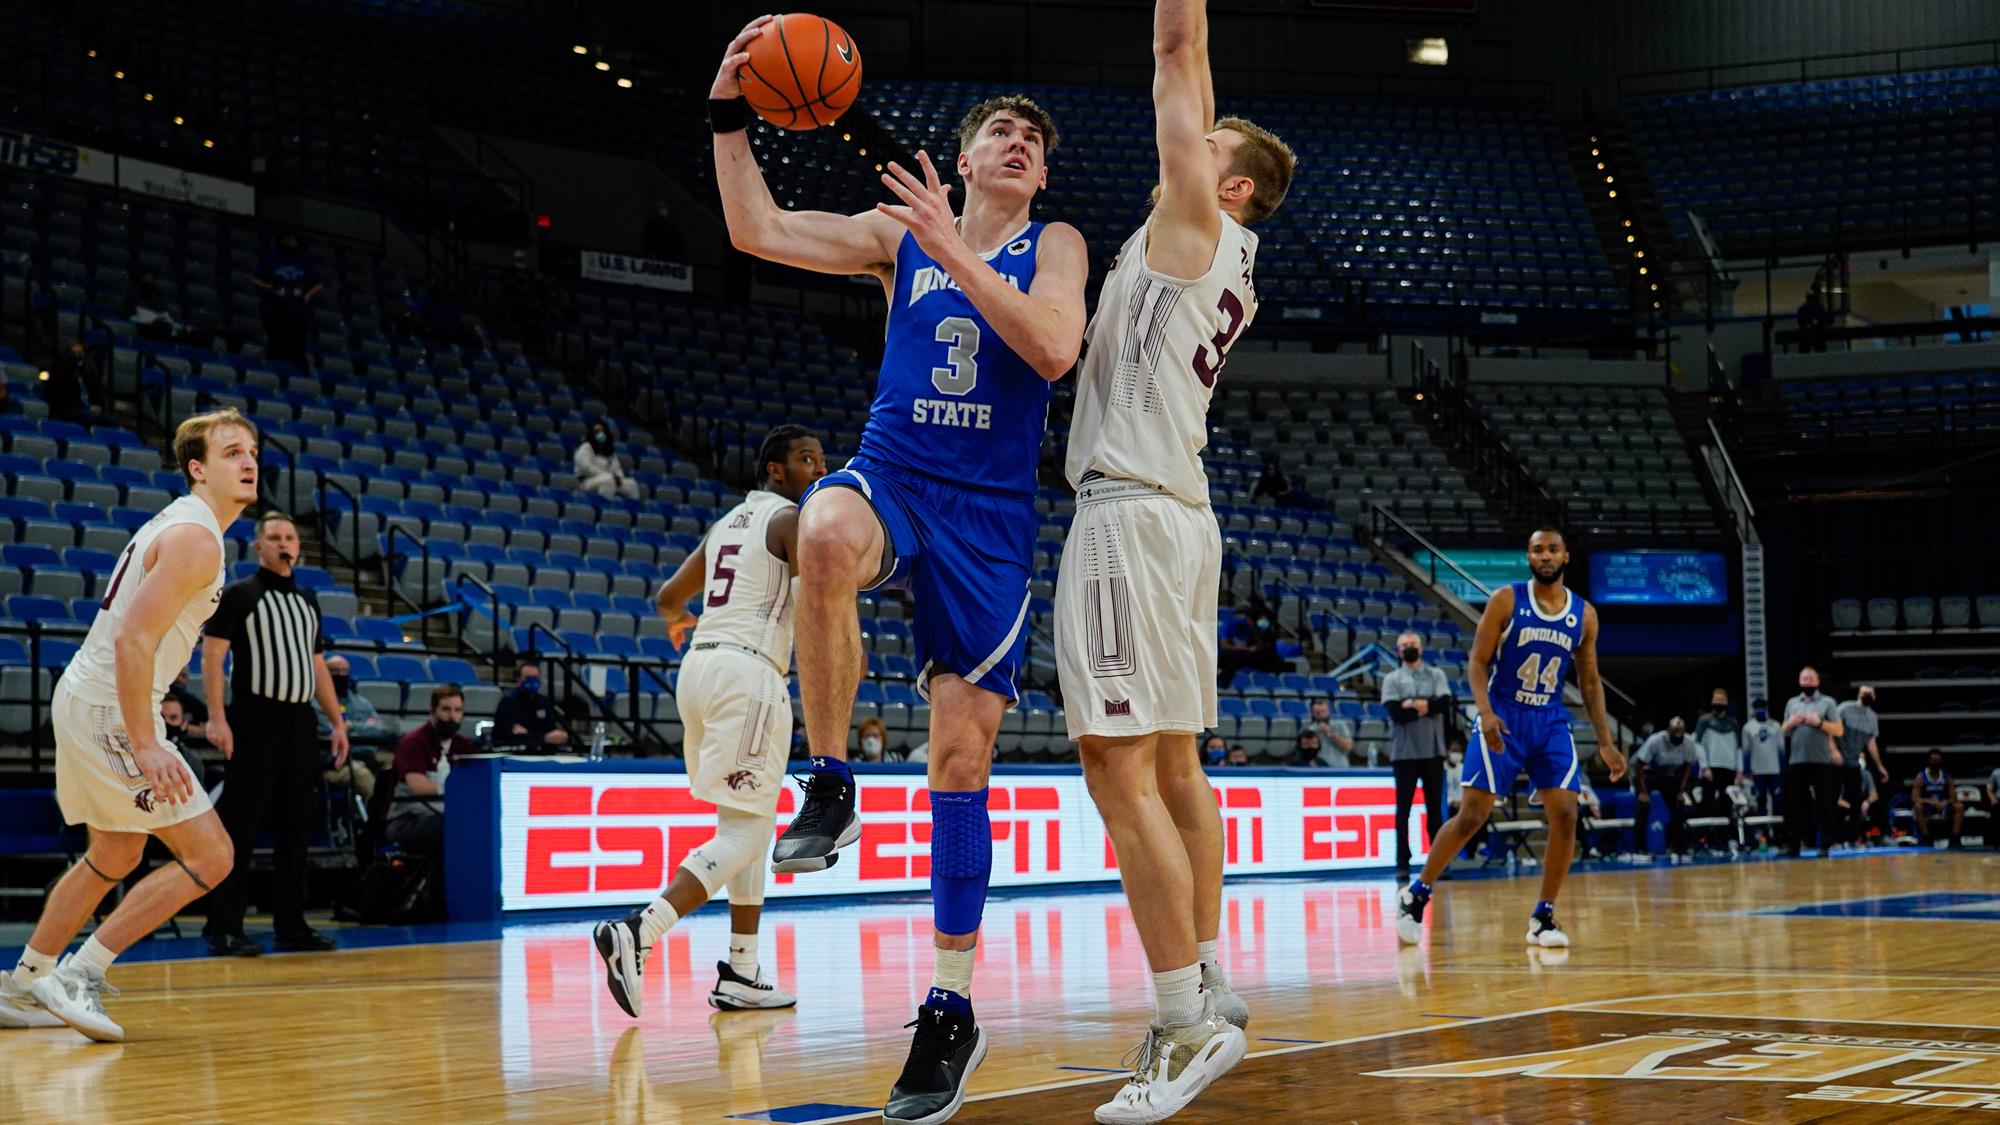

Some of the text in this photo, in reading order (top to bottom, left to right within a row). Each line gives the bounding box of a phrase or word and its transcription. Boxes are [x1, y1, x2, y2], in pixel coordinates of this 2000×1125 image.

[931, 316, 980, 396] 3
[912, 398, 992, 430] STATE
[707, 545, 743, 607] 5
[1517, 626, 1572, 652] INDIANA
[1517, 653, 1561, 693] 44
[1515, 690, 1550, 706] STATE
